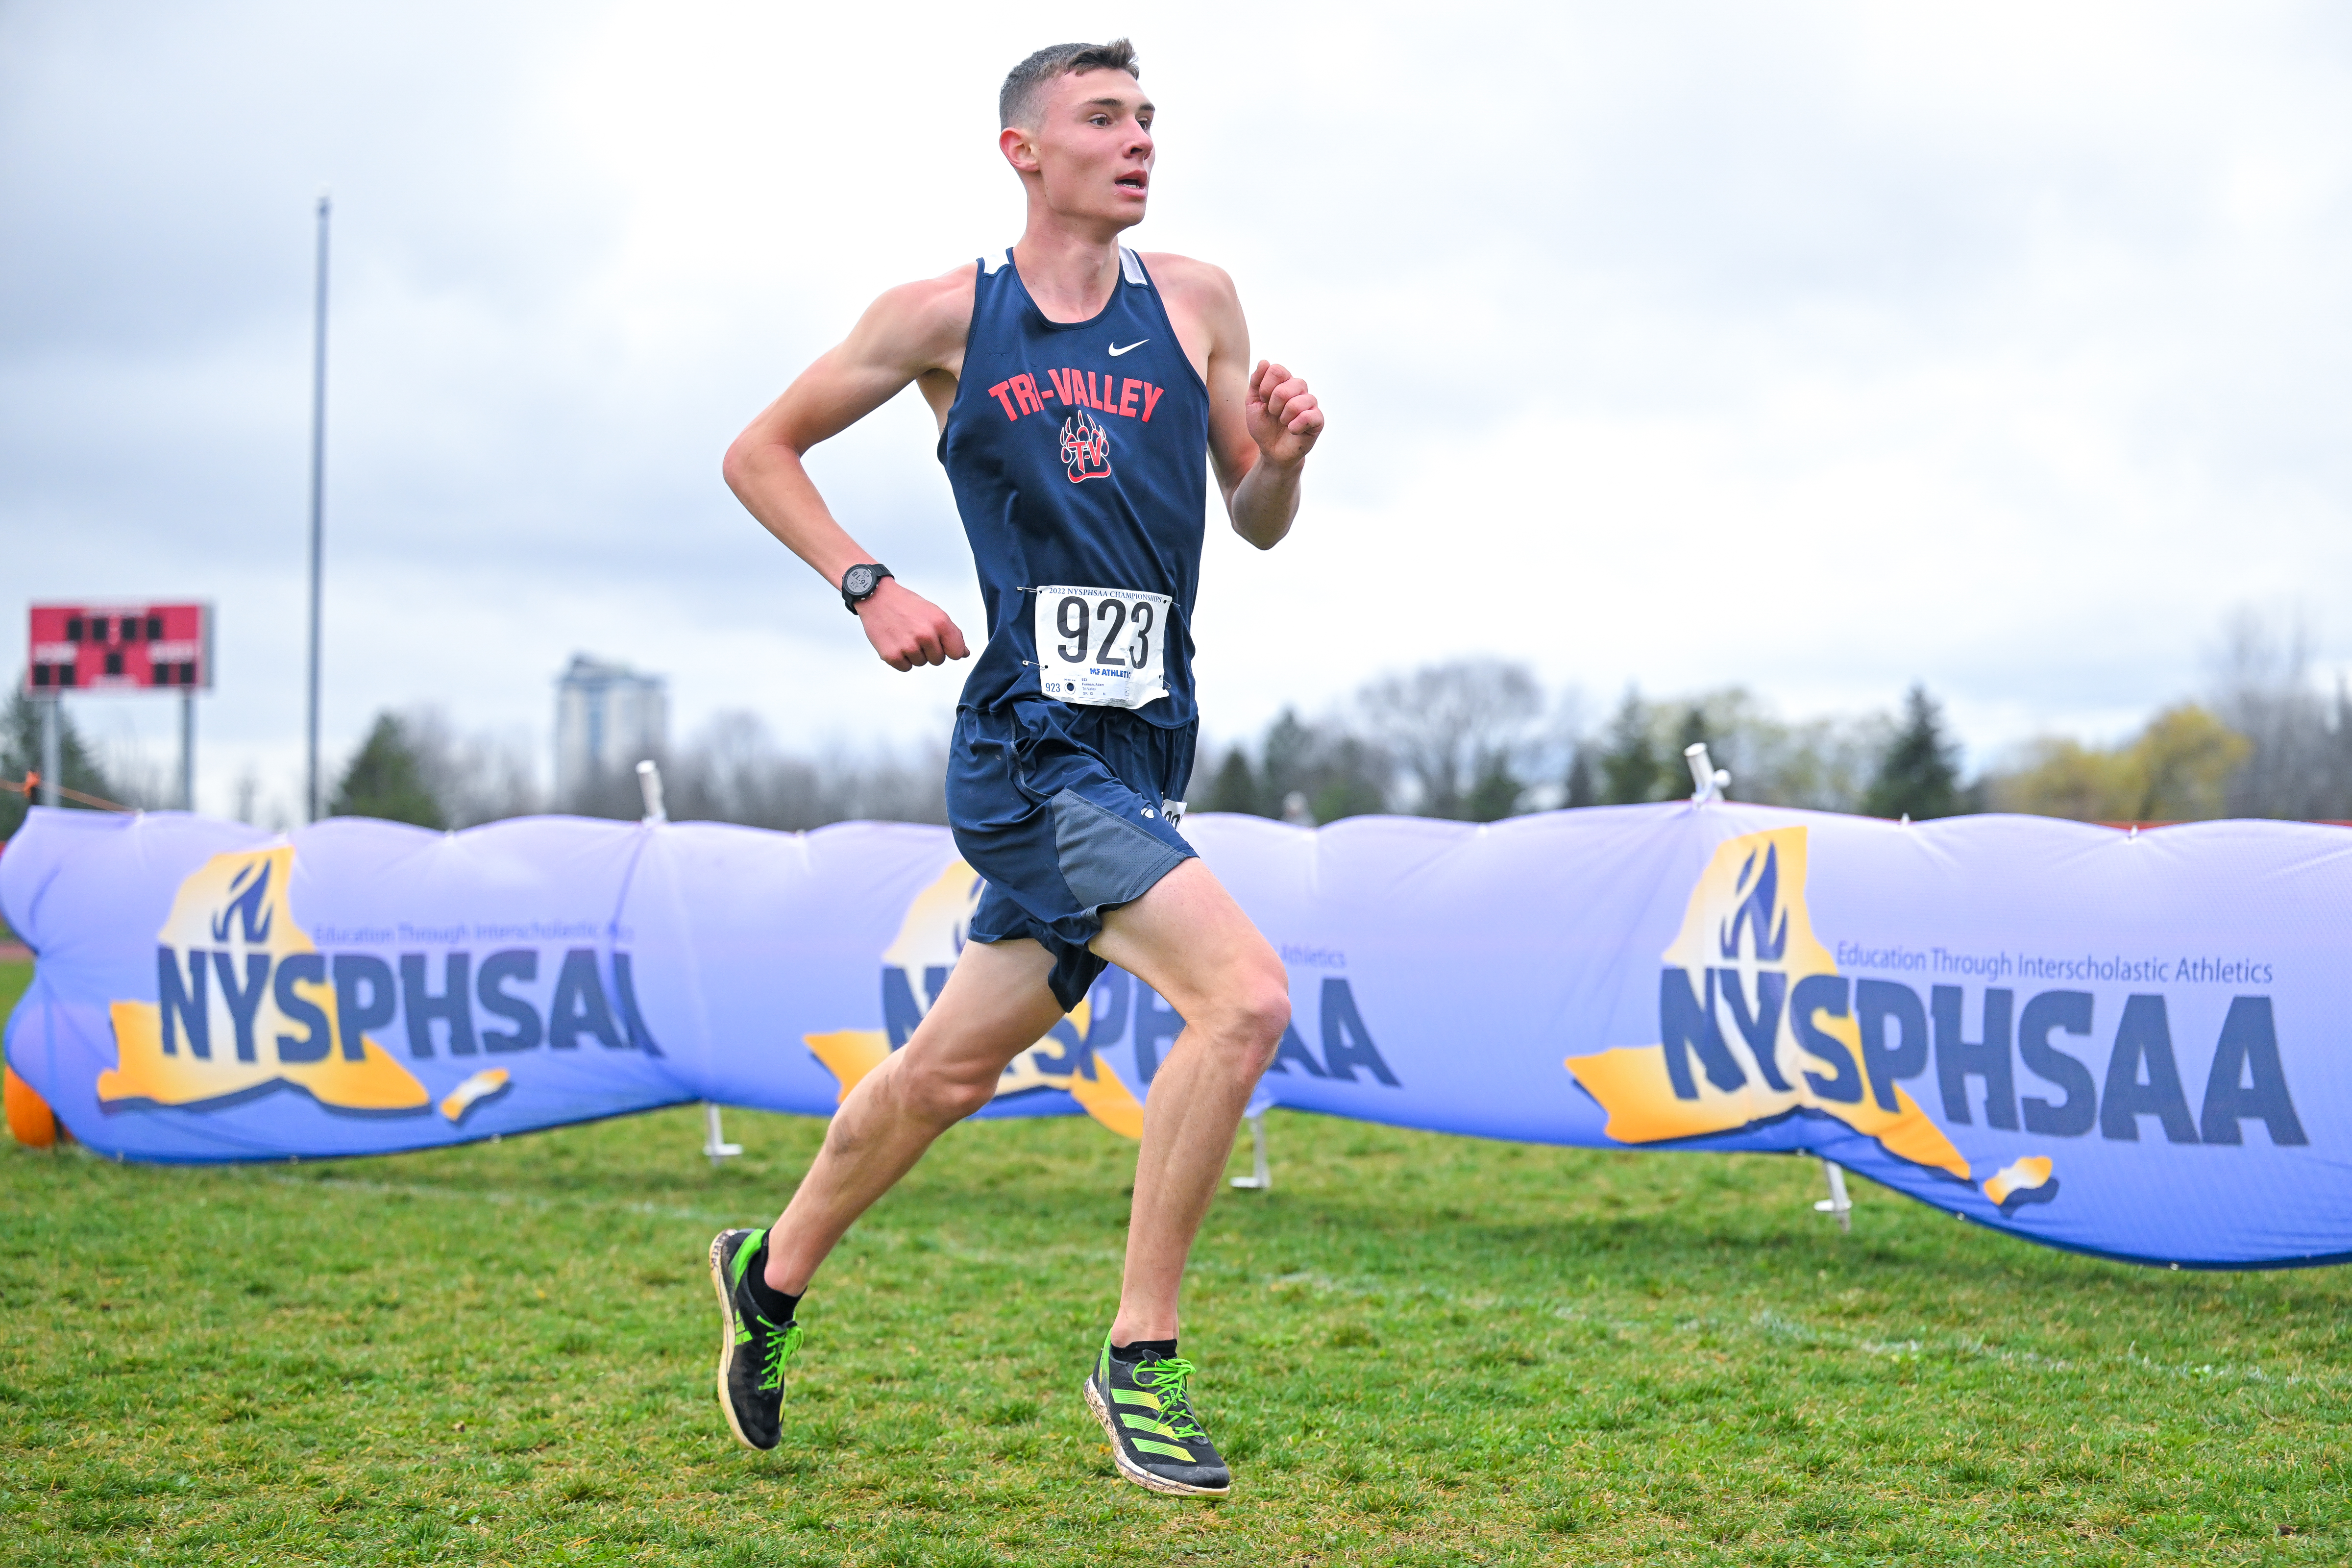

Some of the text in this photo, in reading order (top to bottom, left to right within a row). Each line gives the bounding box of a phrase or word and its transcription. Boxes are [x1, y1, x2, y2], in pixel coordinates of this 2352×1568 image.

[988, 368, 1164, 422] TRI-VALLEY
[852, 571, 868, 588] 16:18
[1067, 588, 1107, 597] NYSPHSAA
[1109, 591, 1162, 603] CHAMPIONSHIPS
[1057, 596, 1153, 669] 923
[1045, 683, 1060, 692] 923
[1838, 940, 2273, 983] Education Through Interscholastic Athletics
[1660, 967, 2310, 1146] NYSPHSAA
